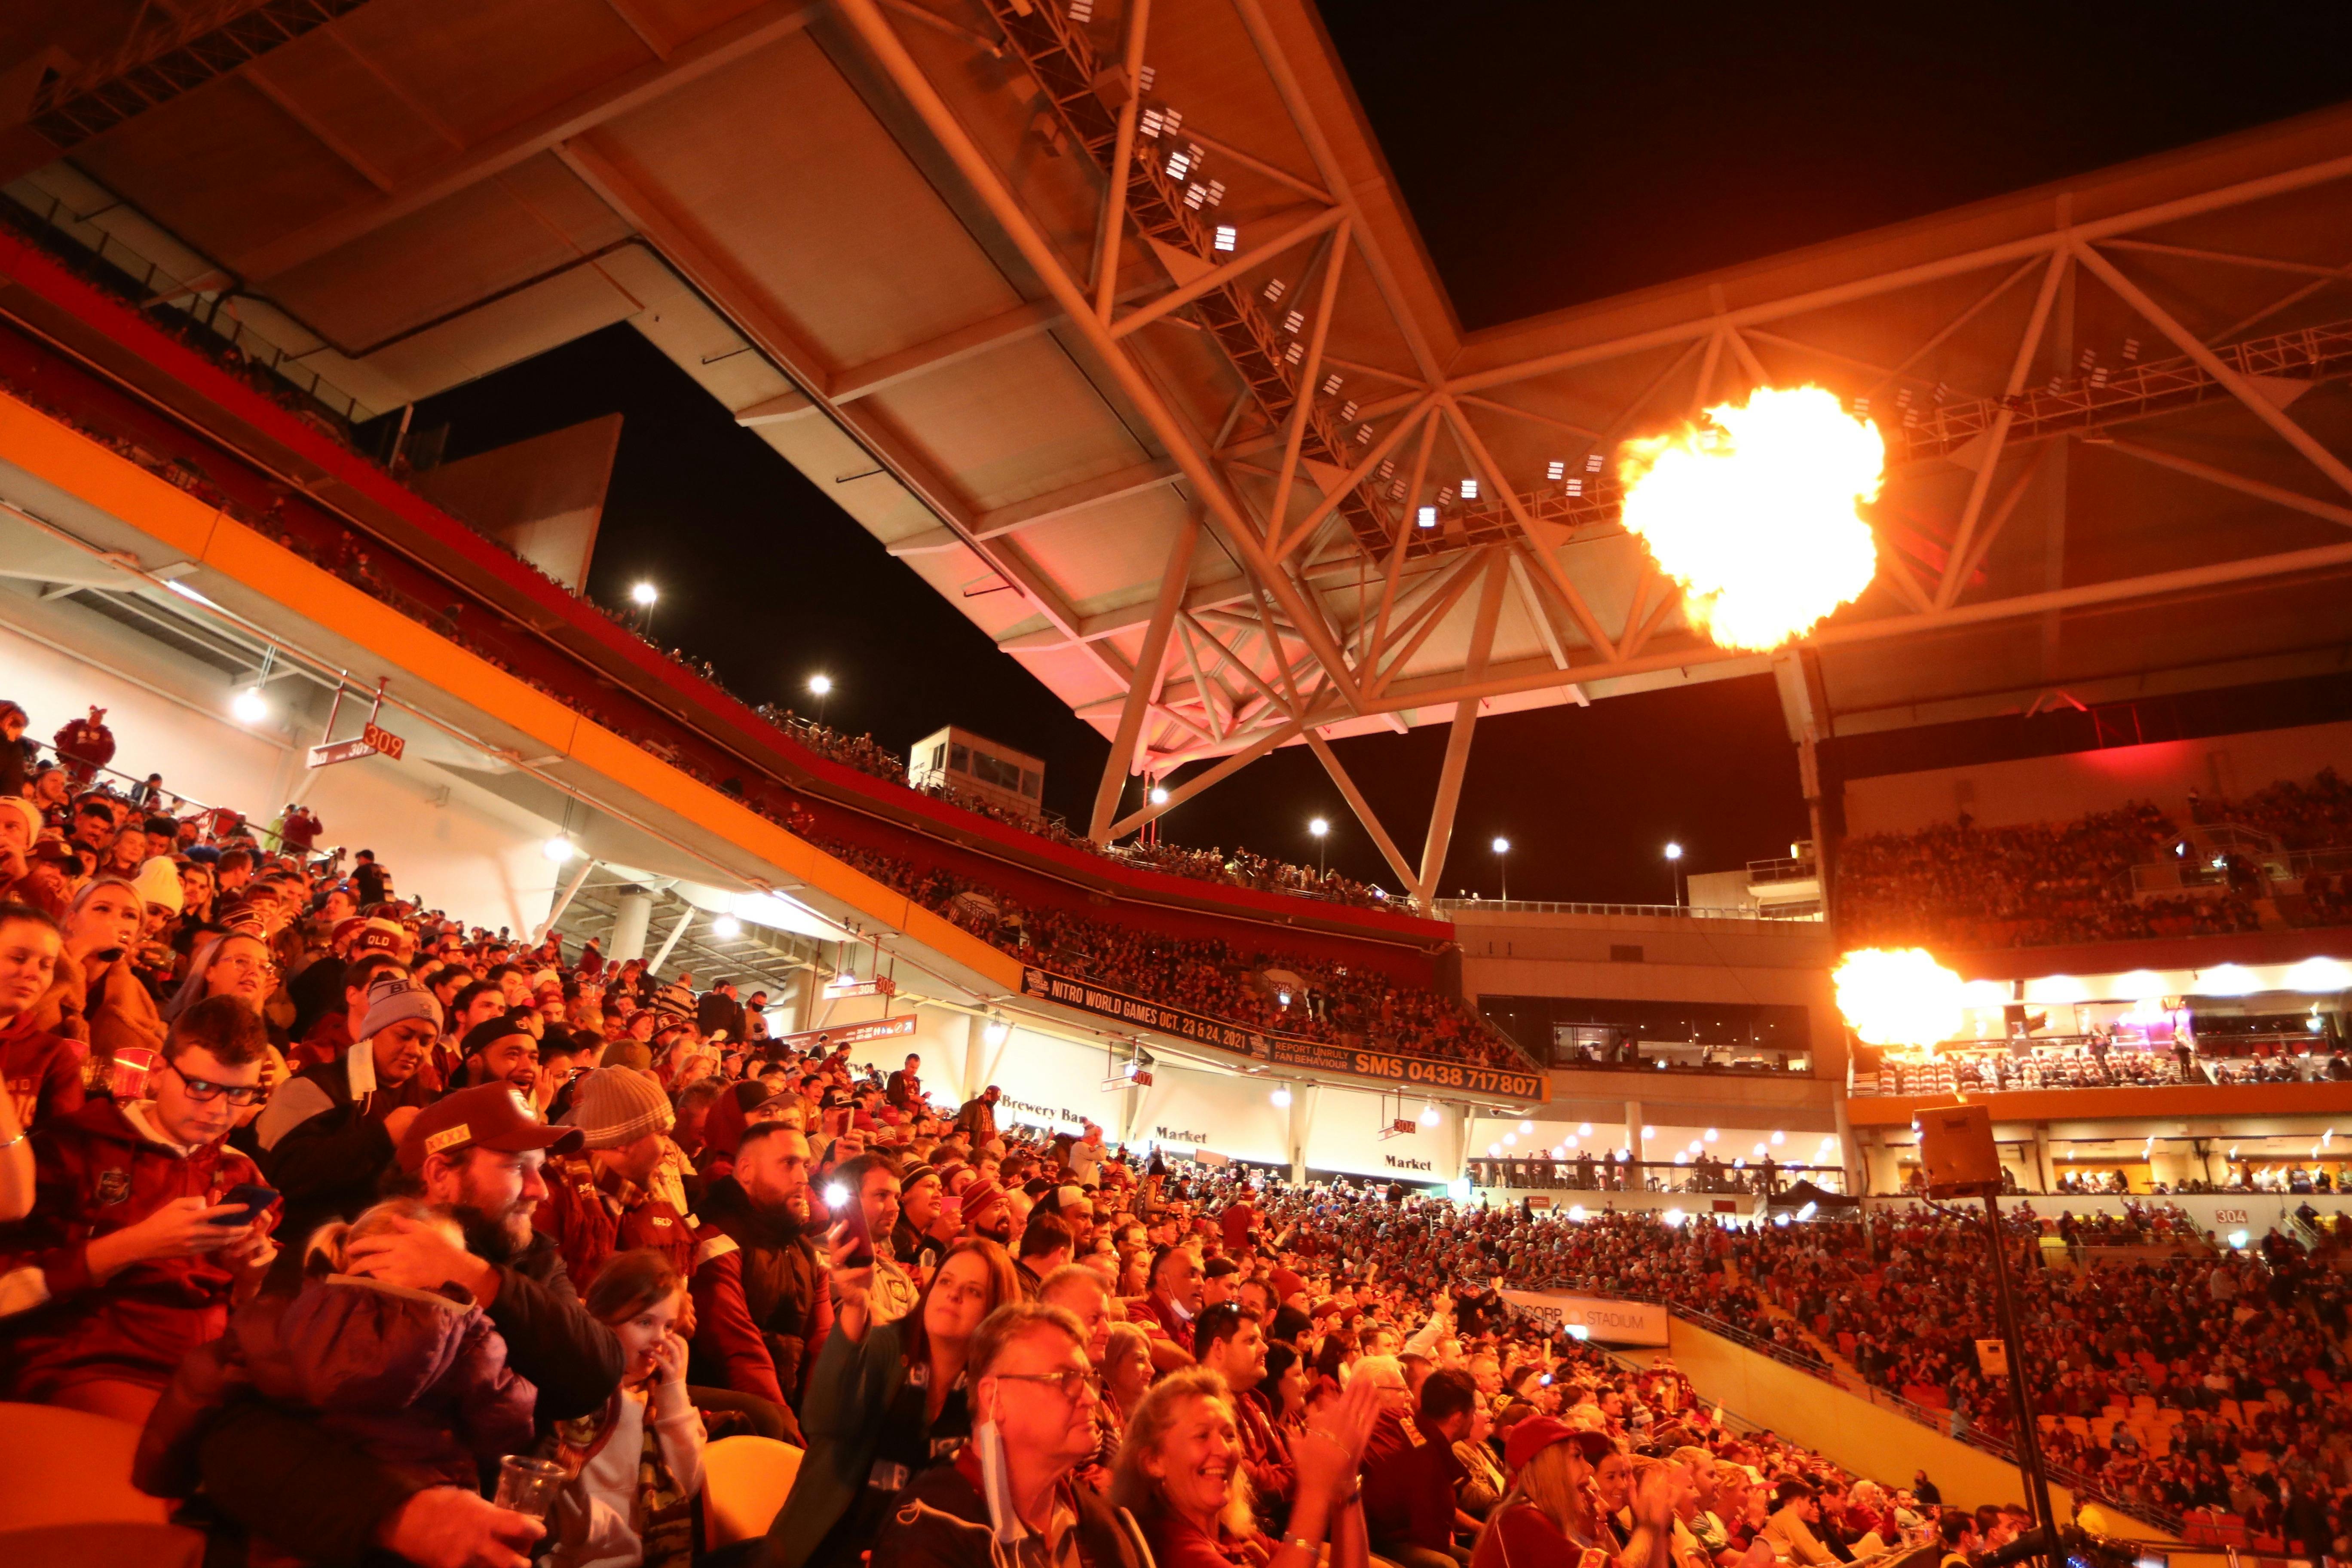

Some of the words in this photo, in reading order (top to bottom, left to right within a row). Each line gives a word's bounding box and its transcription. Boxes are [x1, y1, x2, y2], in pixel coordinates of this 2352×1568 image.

[365, 725, 403, 756] 309
[368, 935, 389, 946] QLD
[858, 984, 876, 994] 308
[877, 976, 894, 995] 308
[1052, 980, 1083, 1003] NITRO
[1086, 989, 1121, 1014] WORLD
[1123, 1001, 1157, 1024] GAMES
[1159, 1011, 1179, 1031] OCT.
[1183, 1018, 1195, 1035] 23
[1197, 1022, 1204, 1037] &
[1206, 1025, 1220, 1043] 24,
[1223, 1030, 1246, 1049] 2021
[1276, 1041, 1311, 1054] REPORT
[1313, 1047, 1349, 1060] UNRULY
[1275, 1052, 1293, 1062] FAN
[1295, 1054, 1348, 1069] BEHAVIOUR
[1355, 1054, 1403, 1078] SMS
[1409, 1062, 1462, 1087] 0438
[1467, 1070, 1538, 1096] 717807
[1001, 1094, 1057, 1120] Brewery
[1394, 1120, 1415, 1133] 306
[1155, 1127, 1207, 1144] Market
[1385, 1155, 1431, 1171] Market
[2217, 1210, 2246, 1222] 304
[1586, 1311, 1645, 1329] STADIUM
